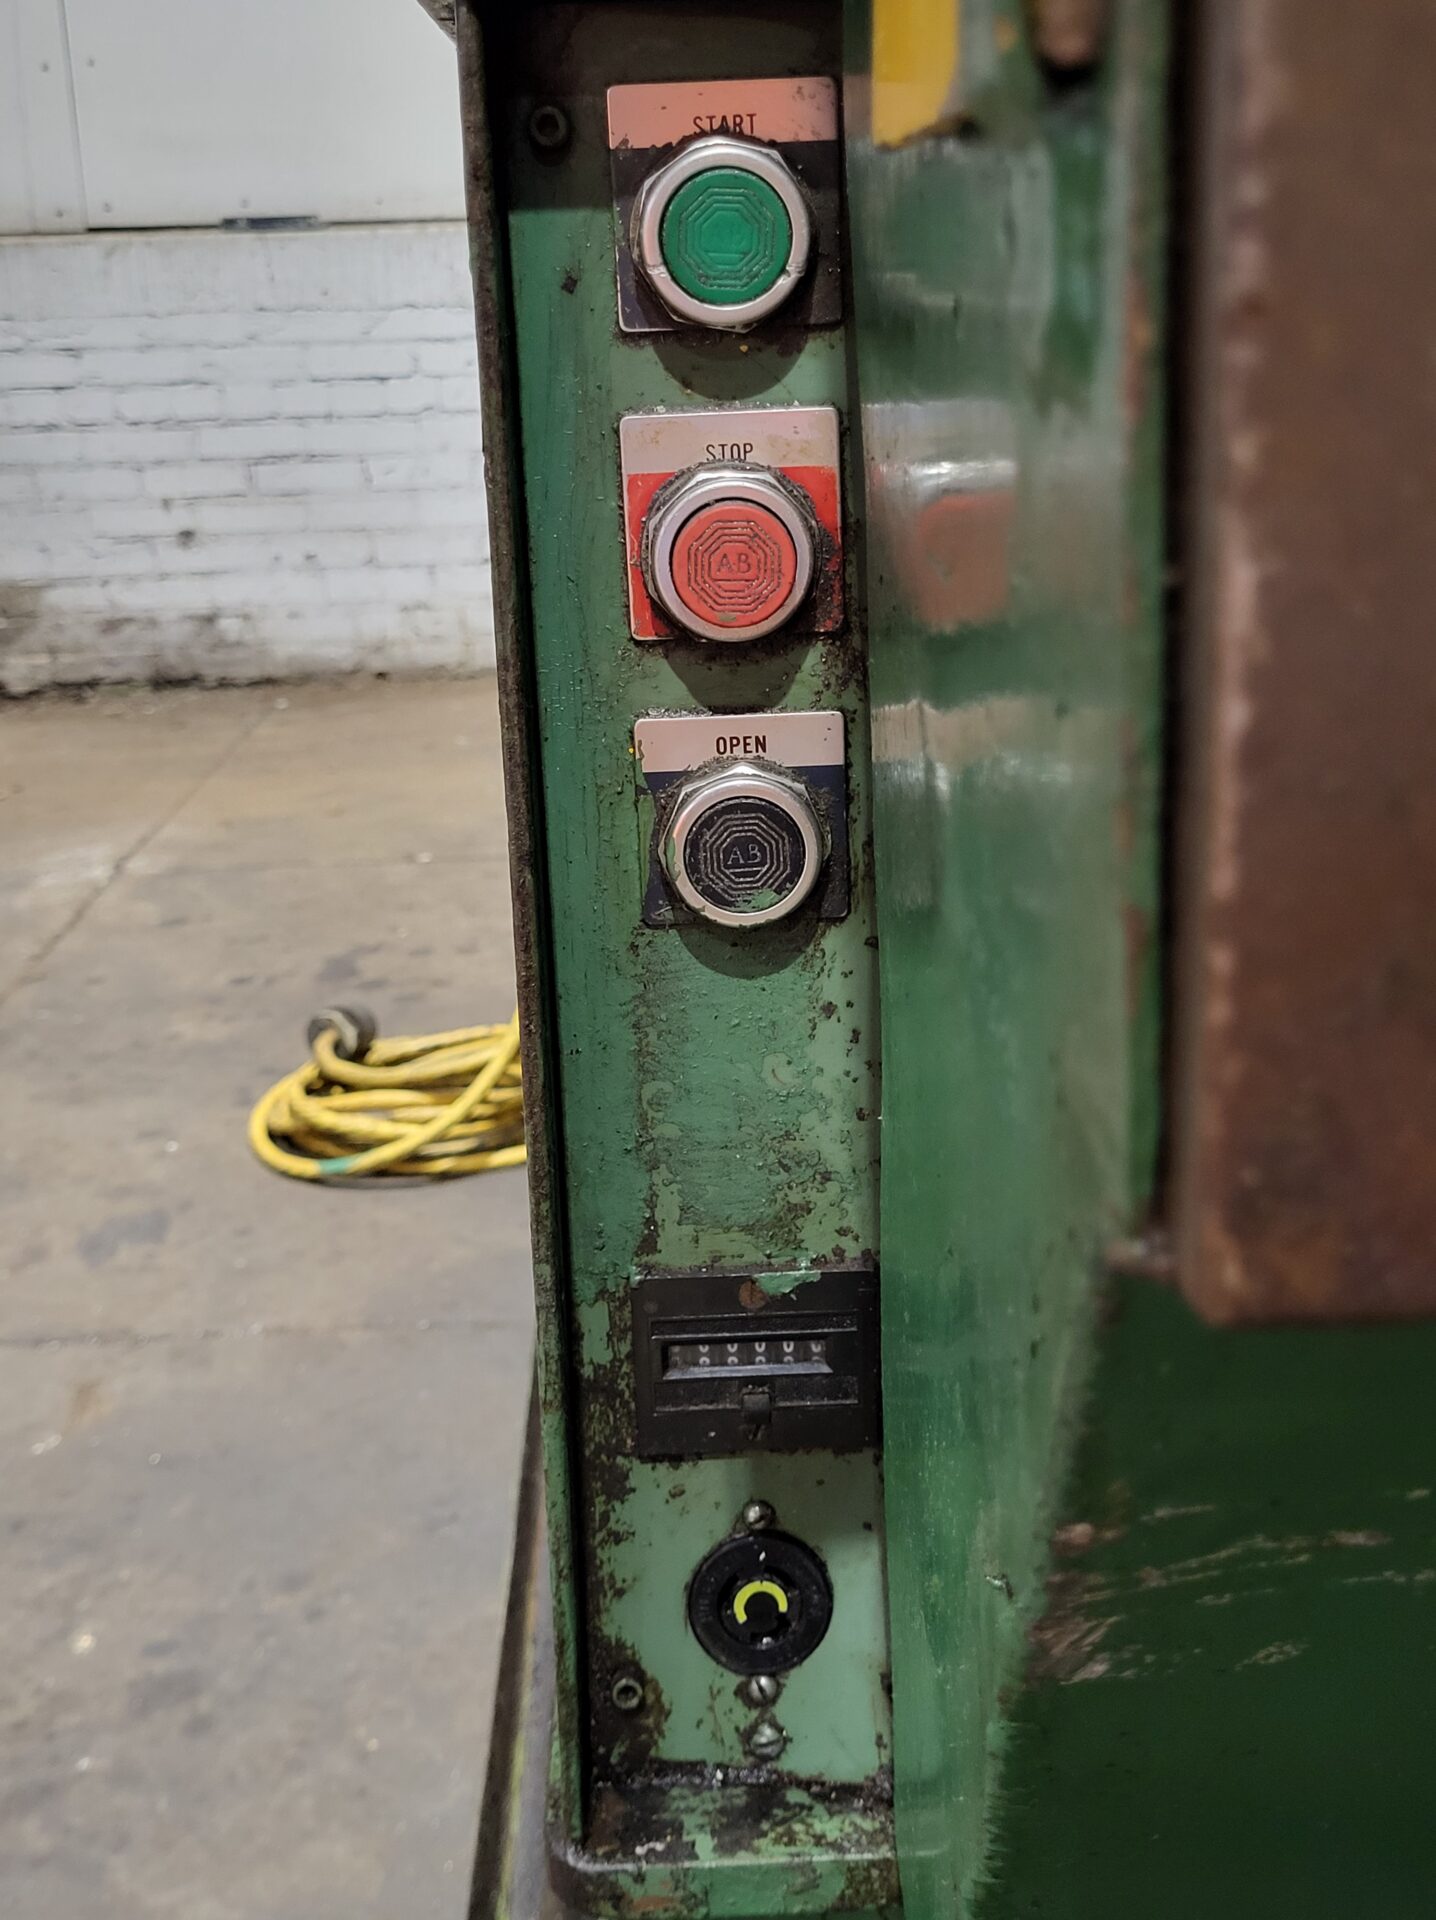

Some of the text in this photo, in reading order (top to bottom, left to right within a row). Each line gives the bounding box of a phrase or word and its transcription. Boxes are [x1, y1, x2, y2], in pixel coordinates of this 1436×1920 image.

[692, 113, 758, 134] START
[705, 442, 754, 462] STOP
[715, 735, 767, 755] OPEN
